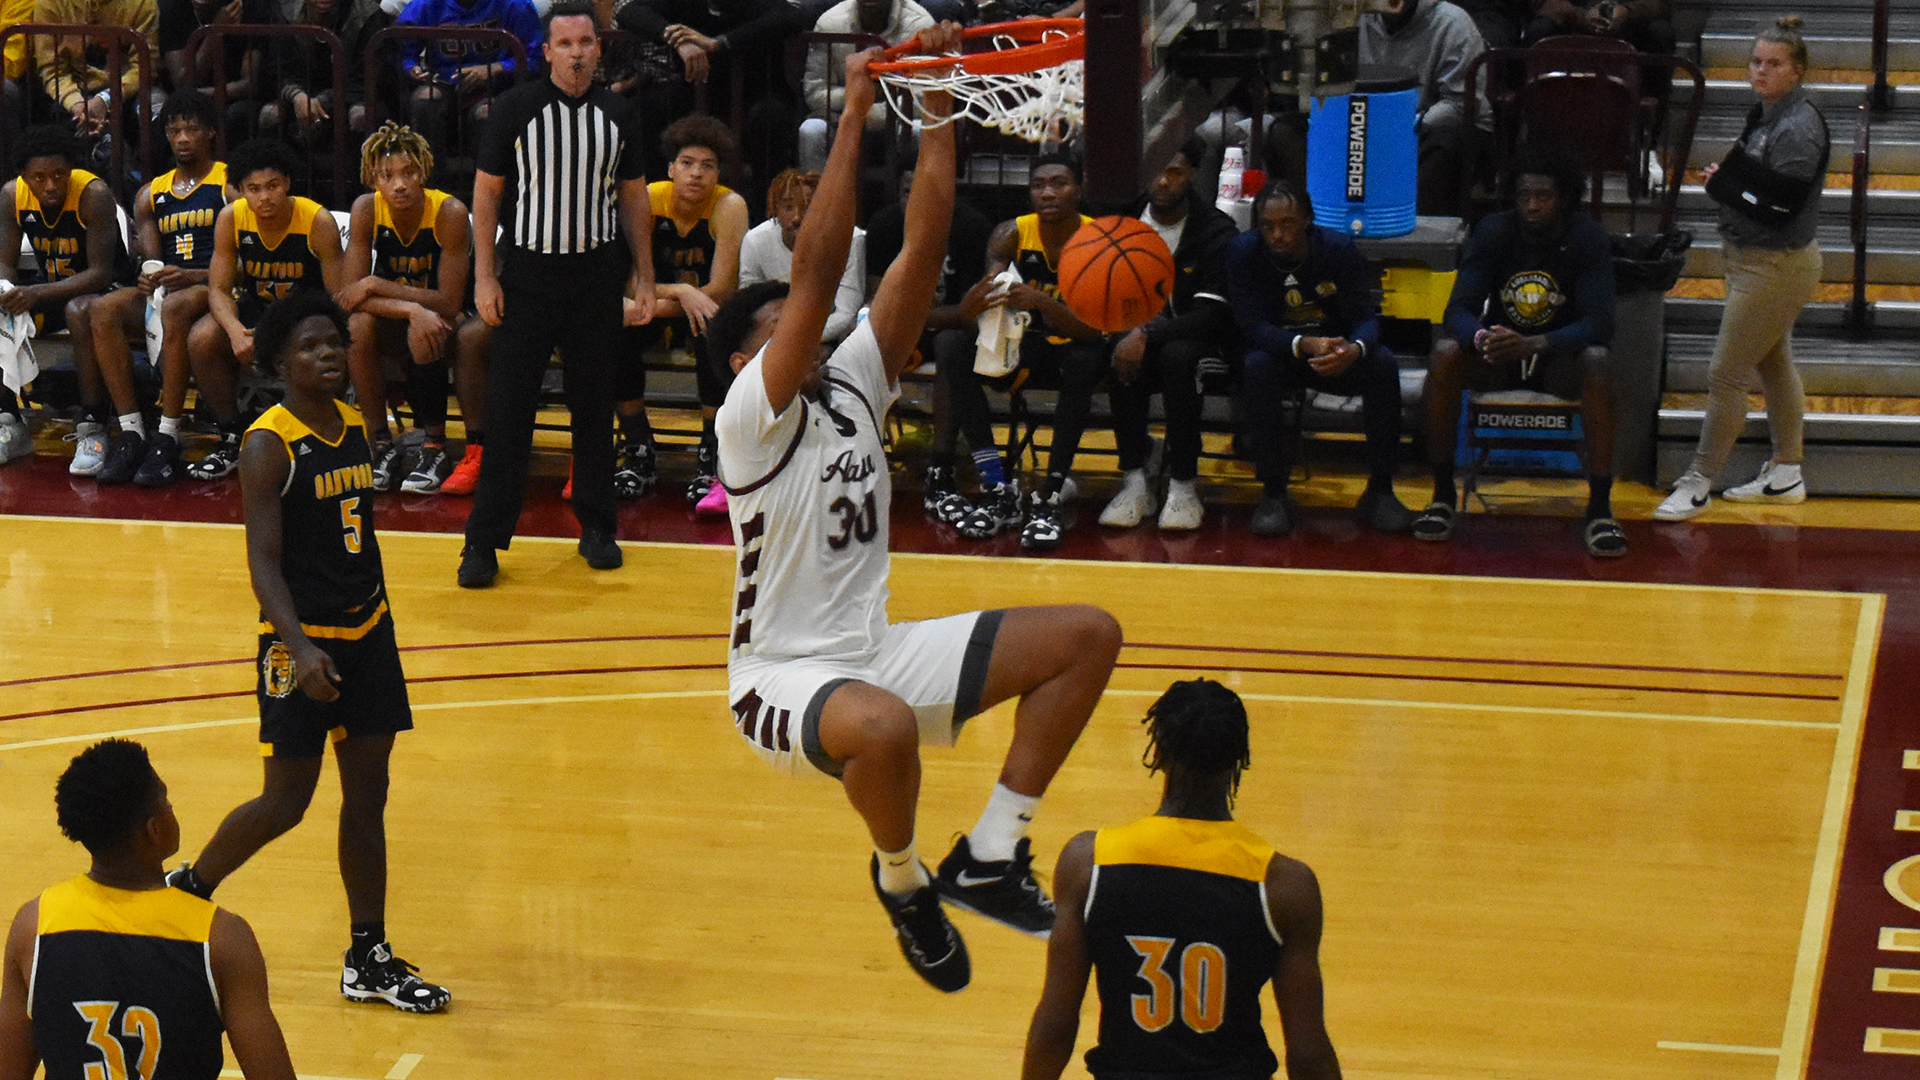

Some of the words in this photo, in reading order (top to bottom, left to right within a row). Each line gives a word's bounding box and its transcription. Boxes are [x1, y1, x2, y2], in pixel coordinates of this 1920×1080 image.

[1348, 101, 1366, 197] POWERADE
[158, 208, 214, 234] OAKWOOD
[175, 233, 194, 260] 4
[1478, 413, 1566, 429] POWERADE
[315, 463, 374, 499] OAKWOOD
[340, 497, 362, 553] 5
[827, 491, 878, 549] 30
[1124, 935, 1227, 1034] 30
[72, 1000, 162, 1080] 32
